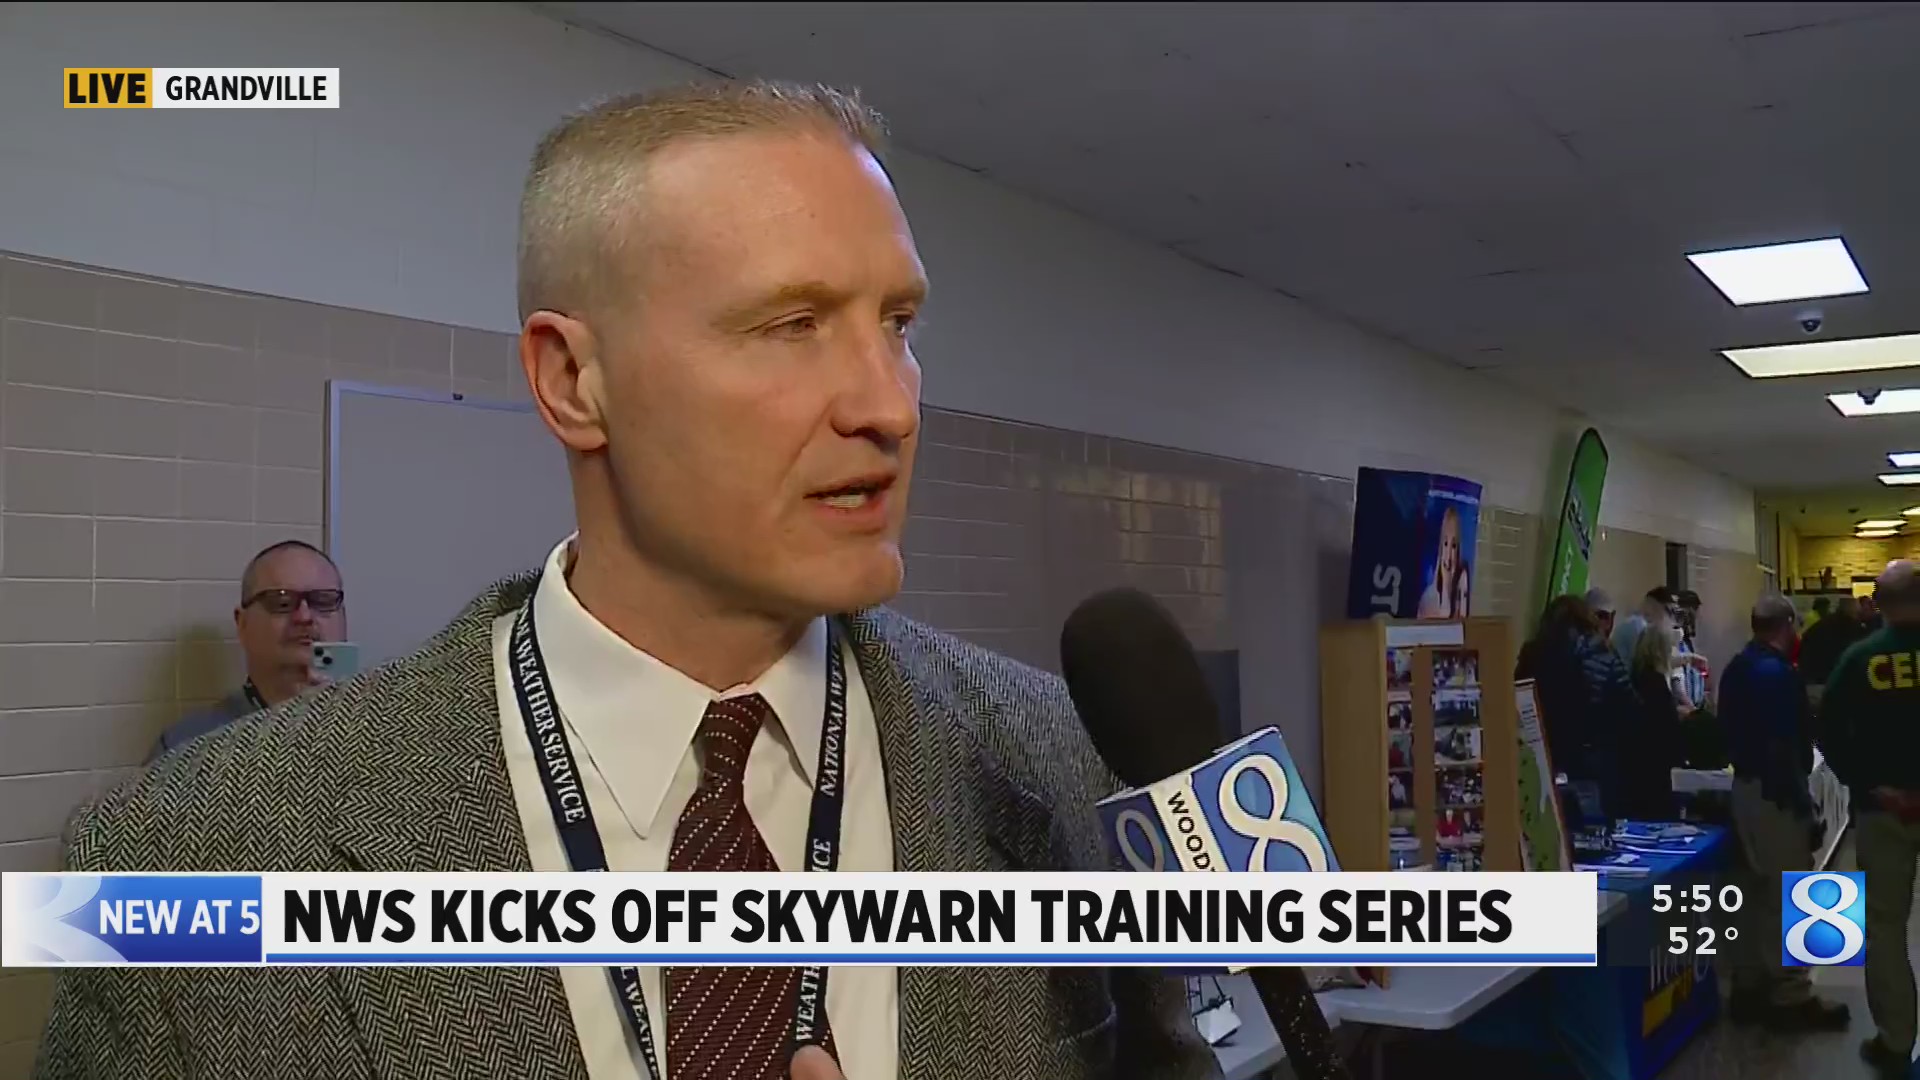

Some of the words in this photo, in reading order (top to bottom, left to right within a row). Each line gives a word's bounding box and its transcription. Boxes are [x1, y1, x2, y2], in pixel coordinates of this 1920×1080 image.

[1866, 651, 1920, 690] CE
[515, 637, 556, 735] WEATHER
[541, 732, 587, 824] SERVICE
[819, 699, 844, 797] NATIONAL
[1167, 790, 1217, 872] WOOD
